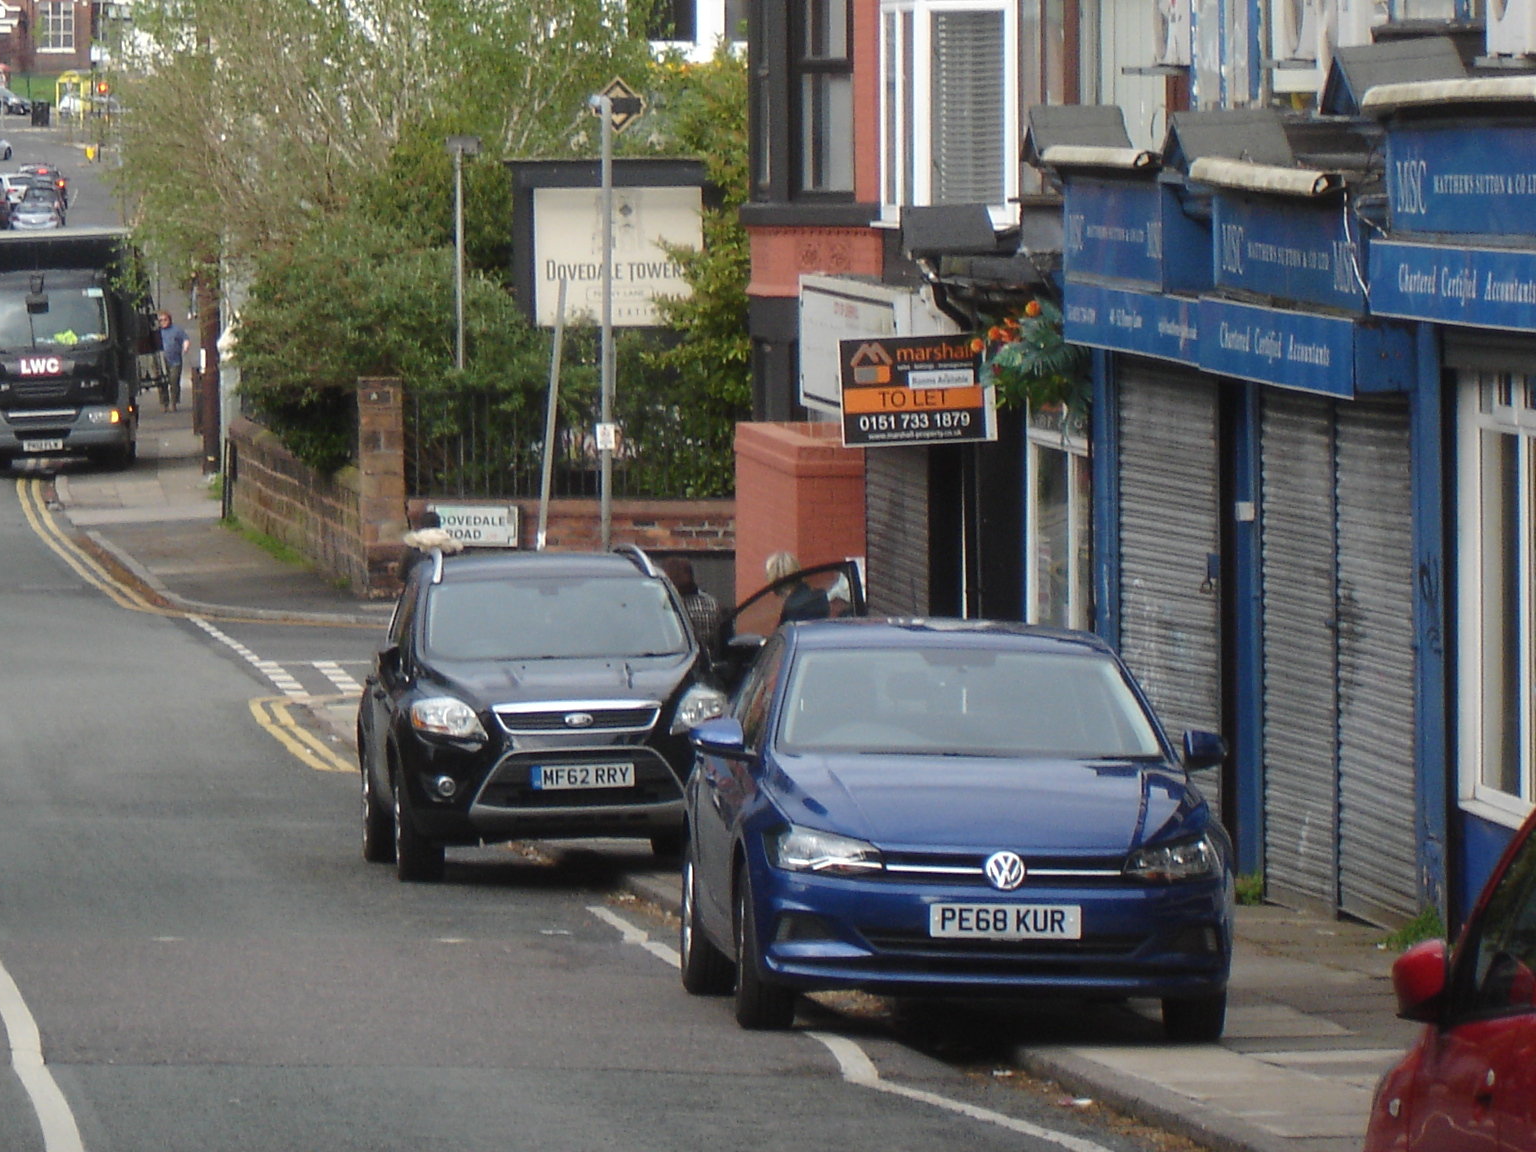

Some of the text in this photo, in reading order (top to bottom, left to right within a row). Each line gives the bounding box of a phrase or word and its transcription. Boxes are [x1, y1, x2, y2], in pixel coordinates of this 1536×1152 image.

[1396, 160, 1427, 214] MSC
[1433, 174, 1474, 194] MATTHEWS
[1474, 174, 1505, 194] SUTTON
[627, 261, 683, 282] TOWER
[1398, 263, 1437, 294] Chartered
[1441, 266, 1477, 307] Certified
[20, 358, 60, 375] LWC
[879, 389, 948, 407] TO LET
[859, 411, 971, 431] 0151 733 1879
[543, 766, 630, 787] MF62 RRY
[940, 907, 1066, 933] PE68 KUR
